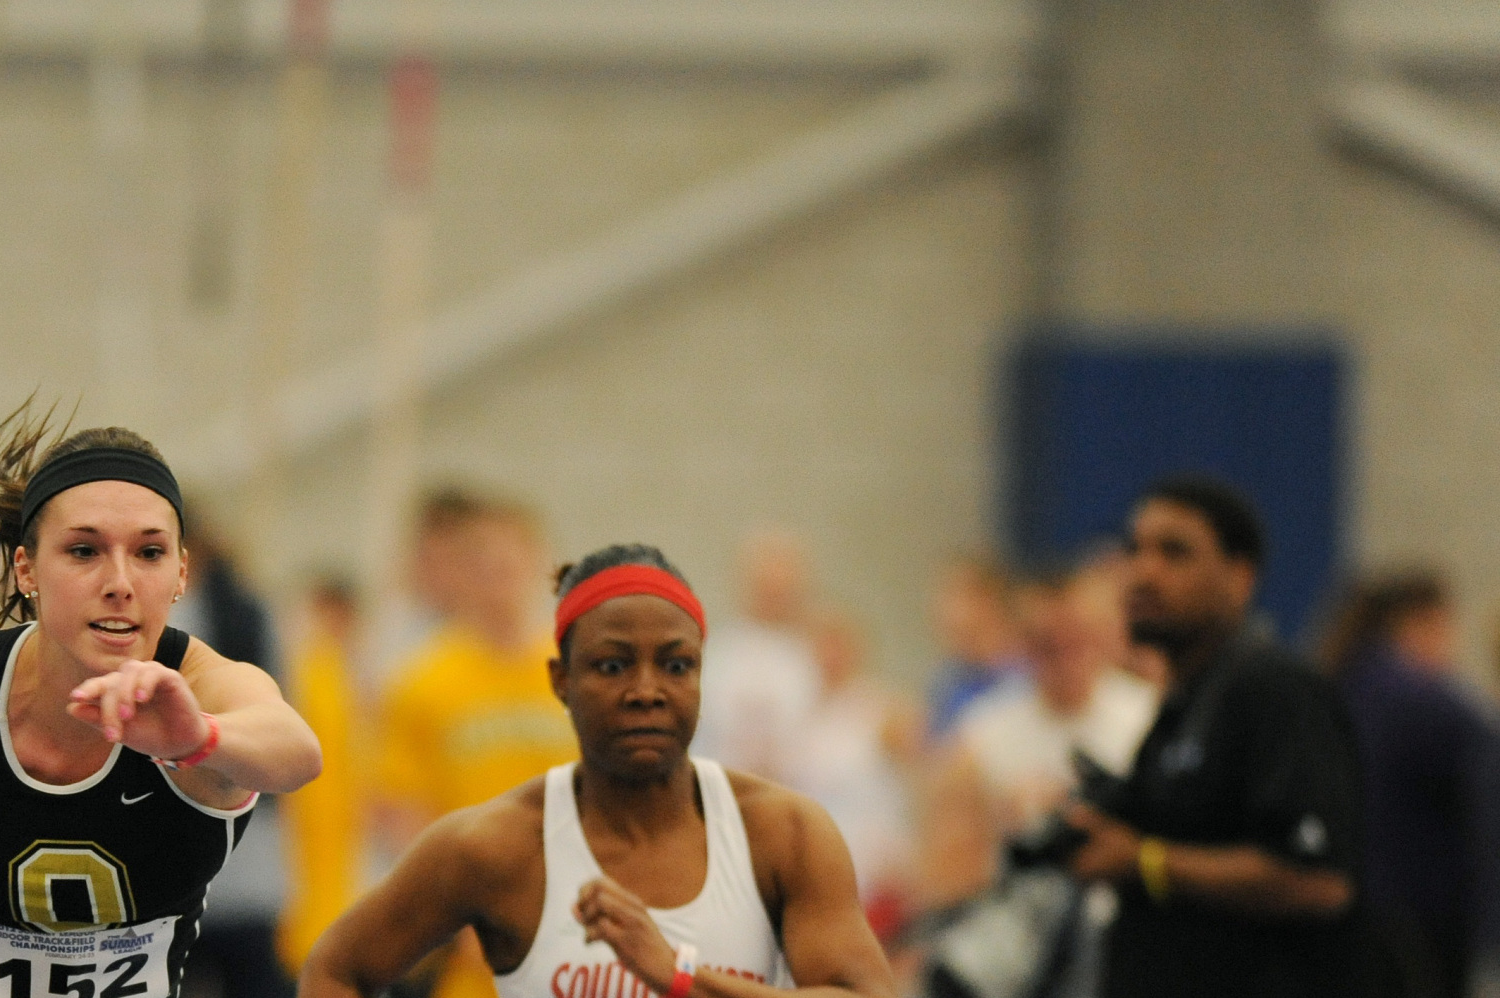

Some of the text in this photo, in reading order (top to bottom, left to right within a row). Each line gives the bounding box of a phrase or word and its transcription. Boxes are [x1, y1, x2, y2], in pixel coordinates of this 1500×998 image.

[33, 934, 96, 946] TRACK&FIELD
[99, 932, 155, 951] SUMMIT
[10, 941, 96, 953] CHAMPIONSHIPS
